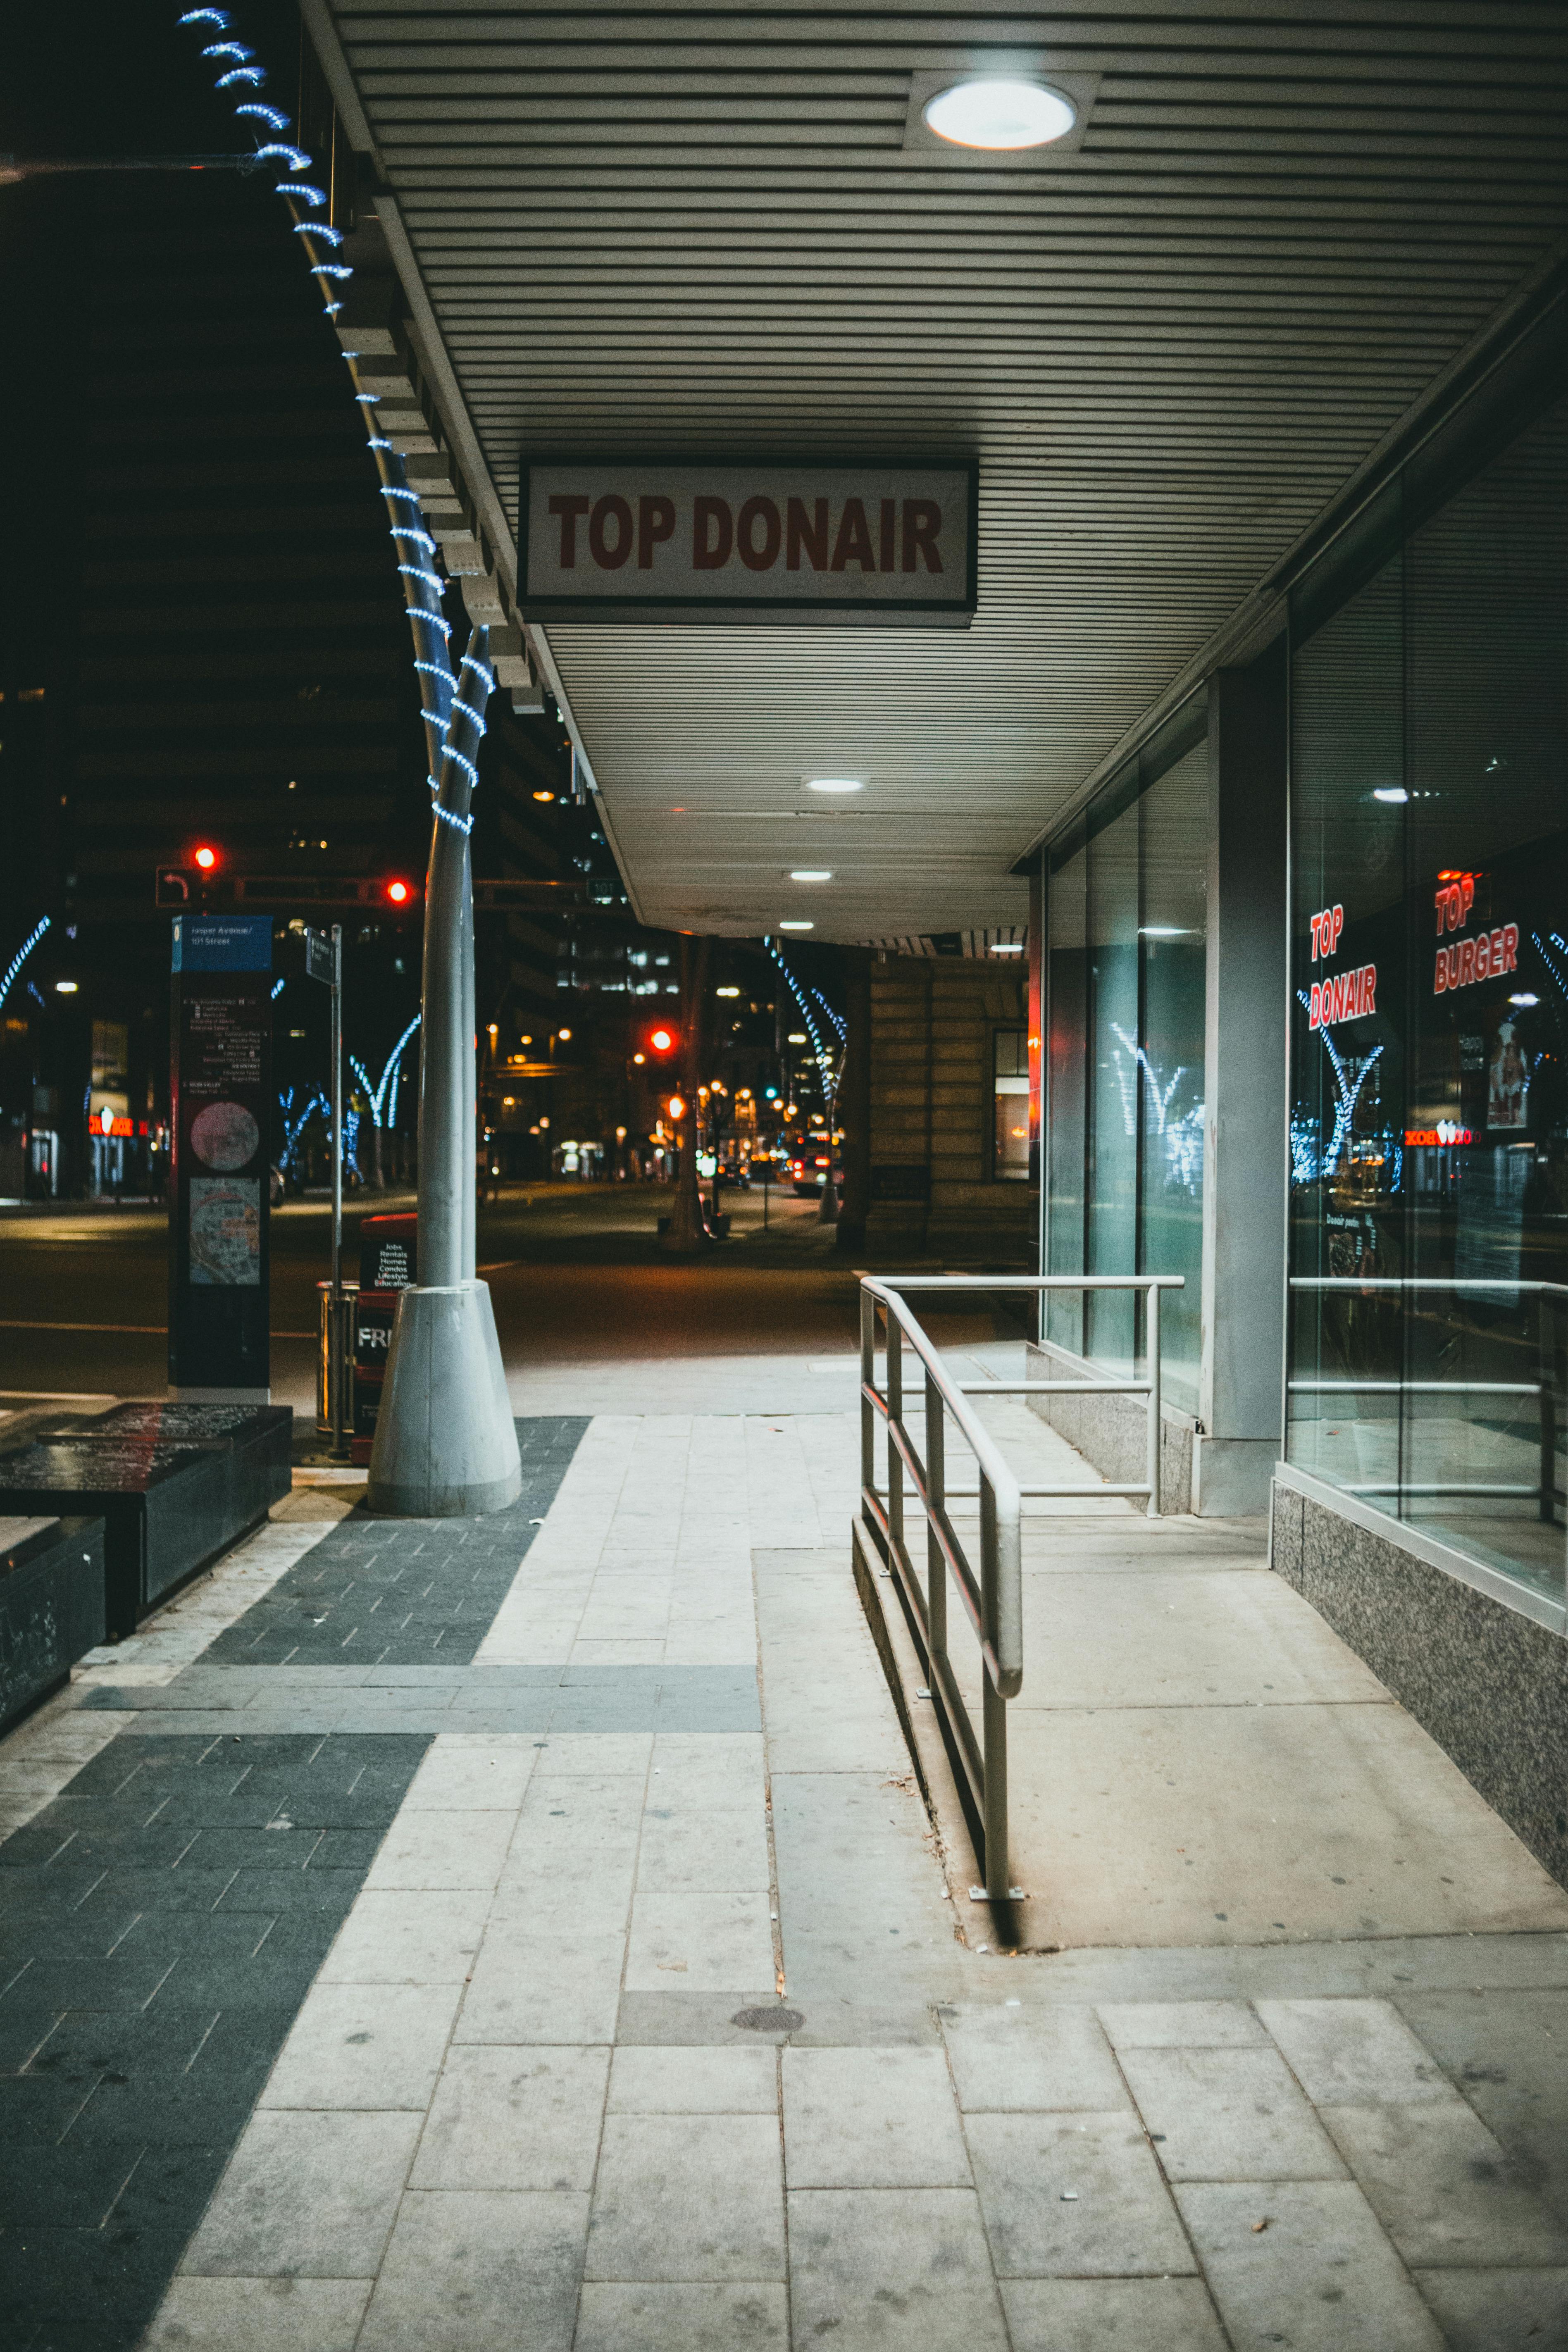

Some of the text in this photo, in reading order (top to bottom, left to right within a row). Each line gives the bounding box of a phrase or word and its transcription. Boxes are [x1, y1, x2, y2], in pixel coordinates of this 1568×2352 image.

[548, 494, 944, 573] TOP DONAIR
[1310, 903, 1343, 963] TOP
[1434, 877, 1474, 937] TOP
[1434, 922, 1519, 995] BURGER
[1309, 963, 1376, 1031] DONAIR
[378, 1272, 408, 1280] Lifestyle
